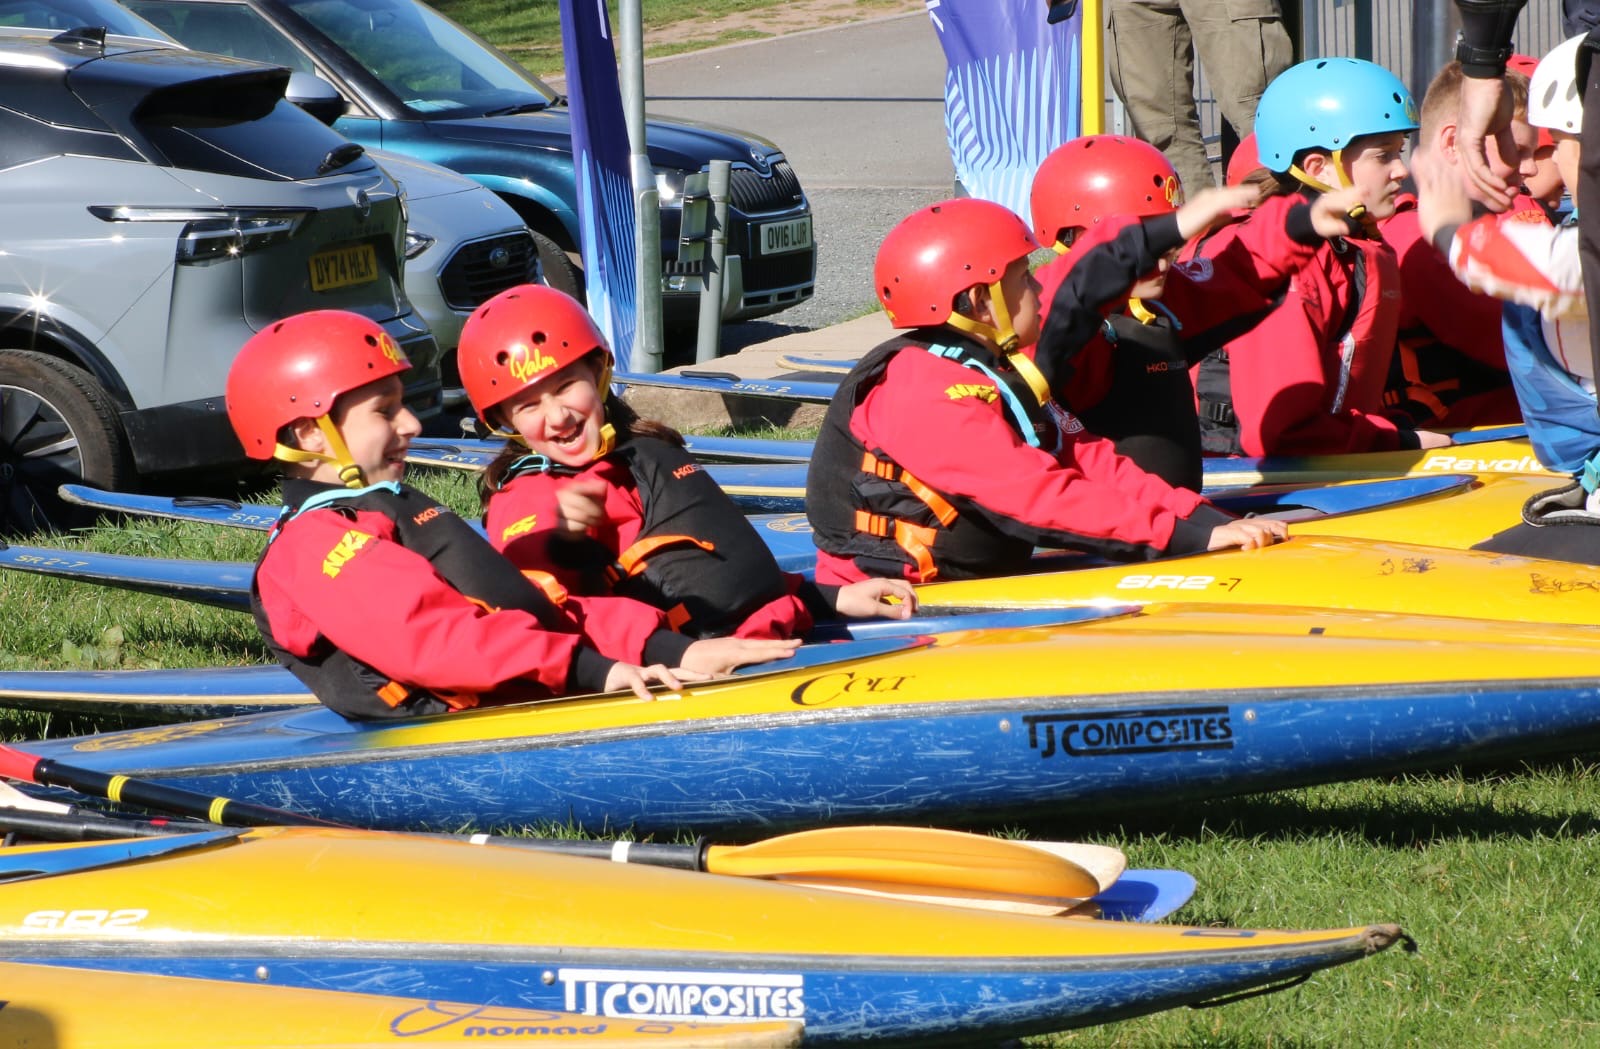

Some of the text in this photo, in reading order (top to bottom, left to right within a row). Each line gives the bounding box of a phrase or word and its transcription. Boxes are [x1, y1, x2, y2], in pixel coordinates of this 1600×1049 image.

[767, 225, 789, 250] OV16
[315, 250, 347, 285] DY74
[510, 344, 558, 383] Palm
[1116, 574, 1215, 590] SR2
[463, 1024, 608, 1037] nomad
